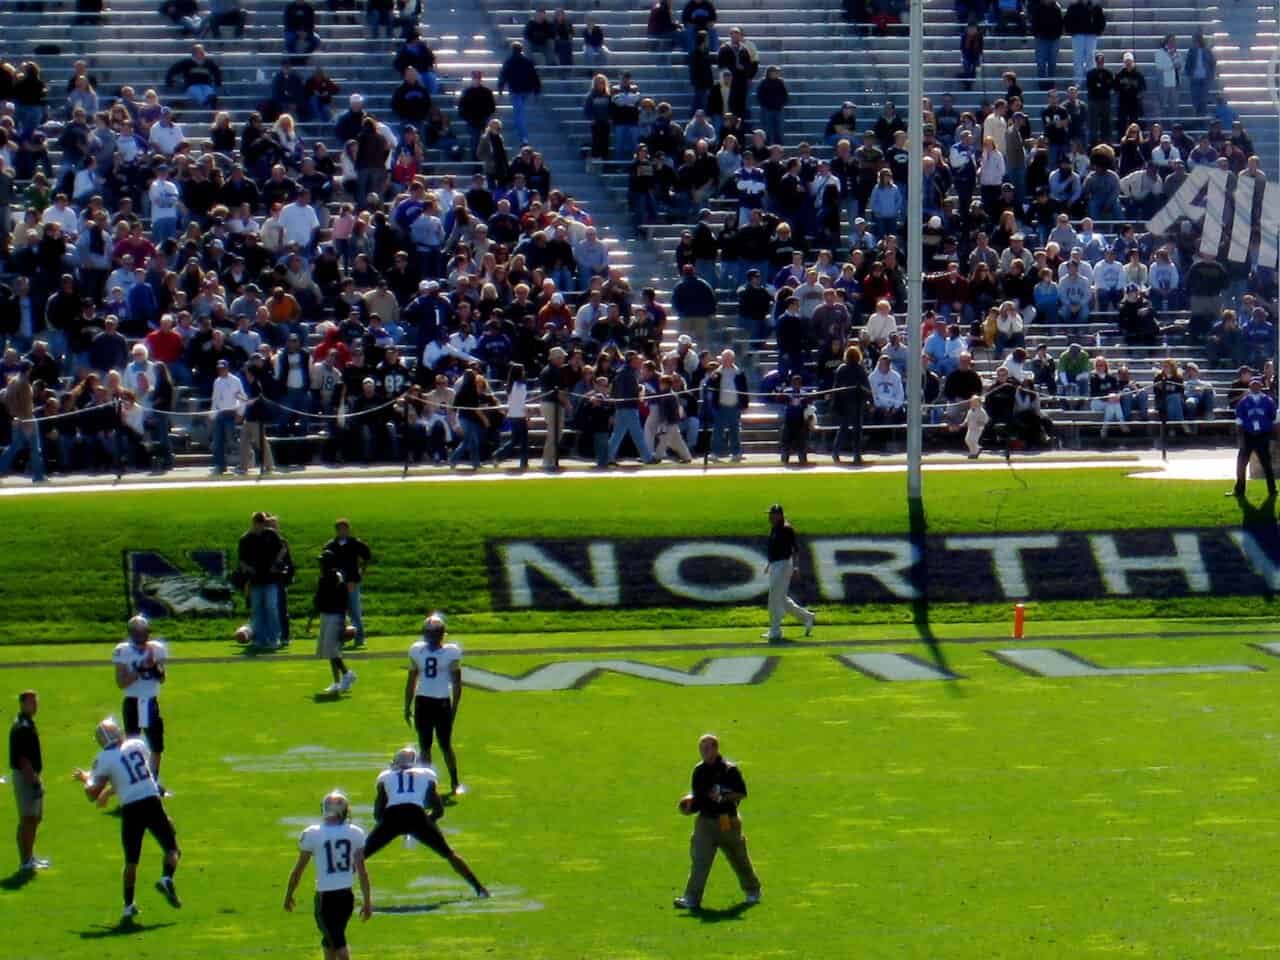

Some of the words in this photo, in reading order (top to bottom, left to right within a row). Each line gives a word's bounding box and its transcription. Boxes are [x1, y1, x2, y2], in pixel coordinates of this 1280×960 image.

[424, 656, 438, 678] 8
[120, 750, 151, 784] 12
[396, 771, 415, 793] 11
[323, 839, 352, 874] 13
